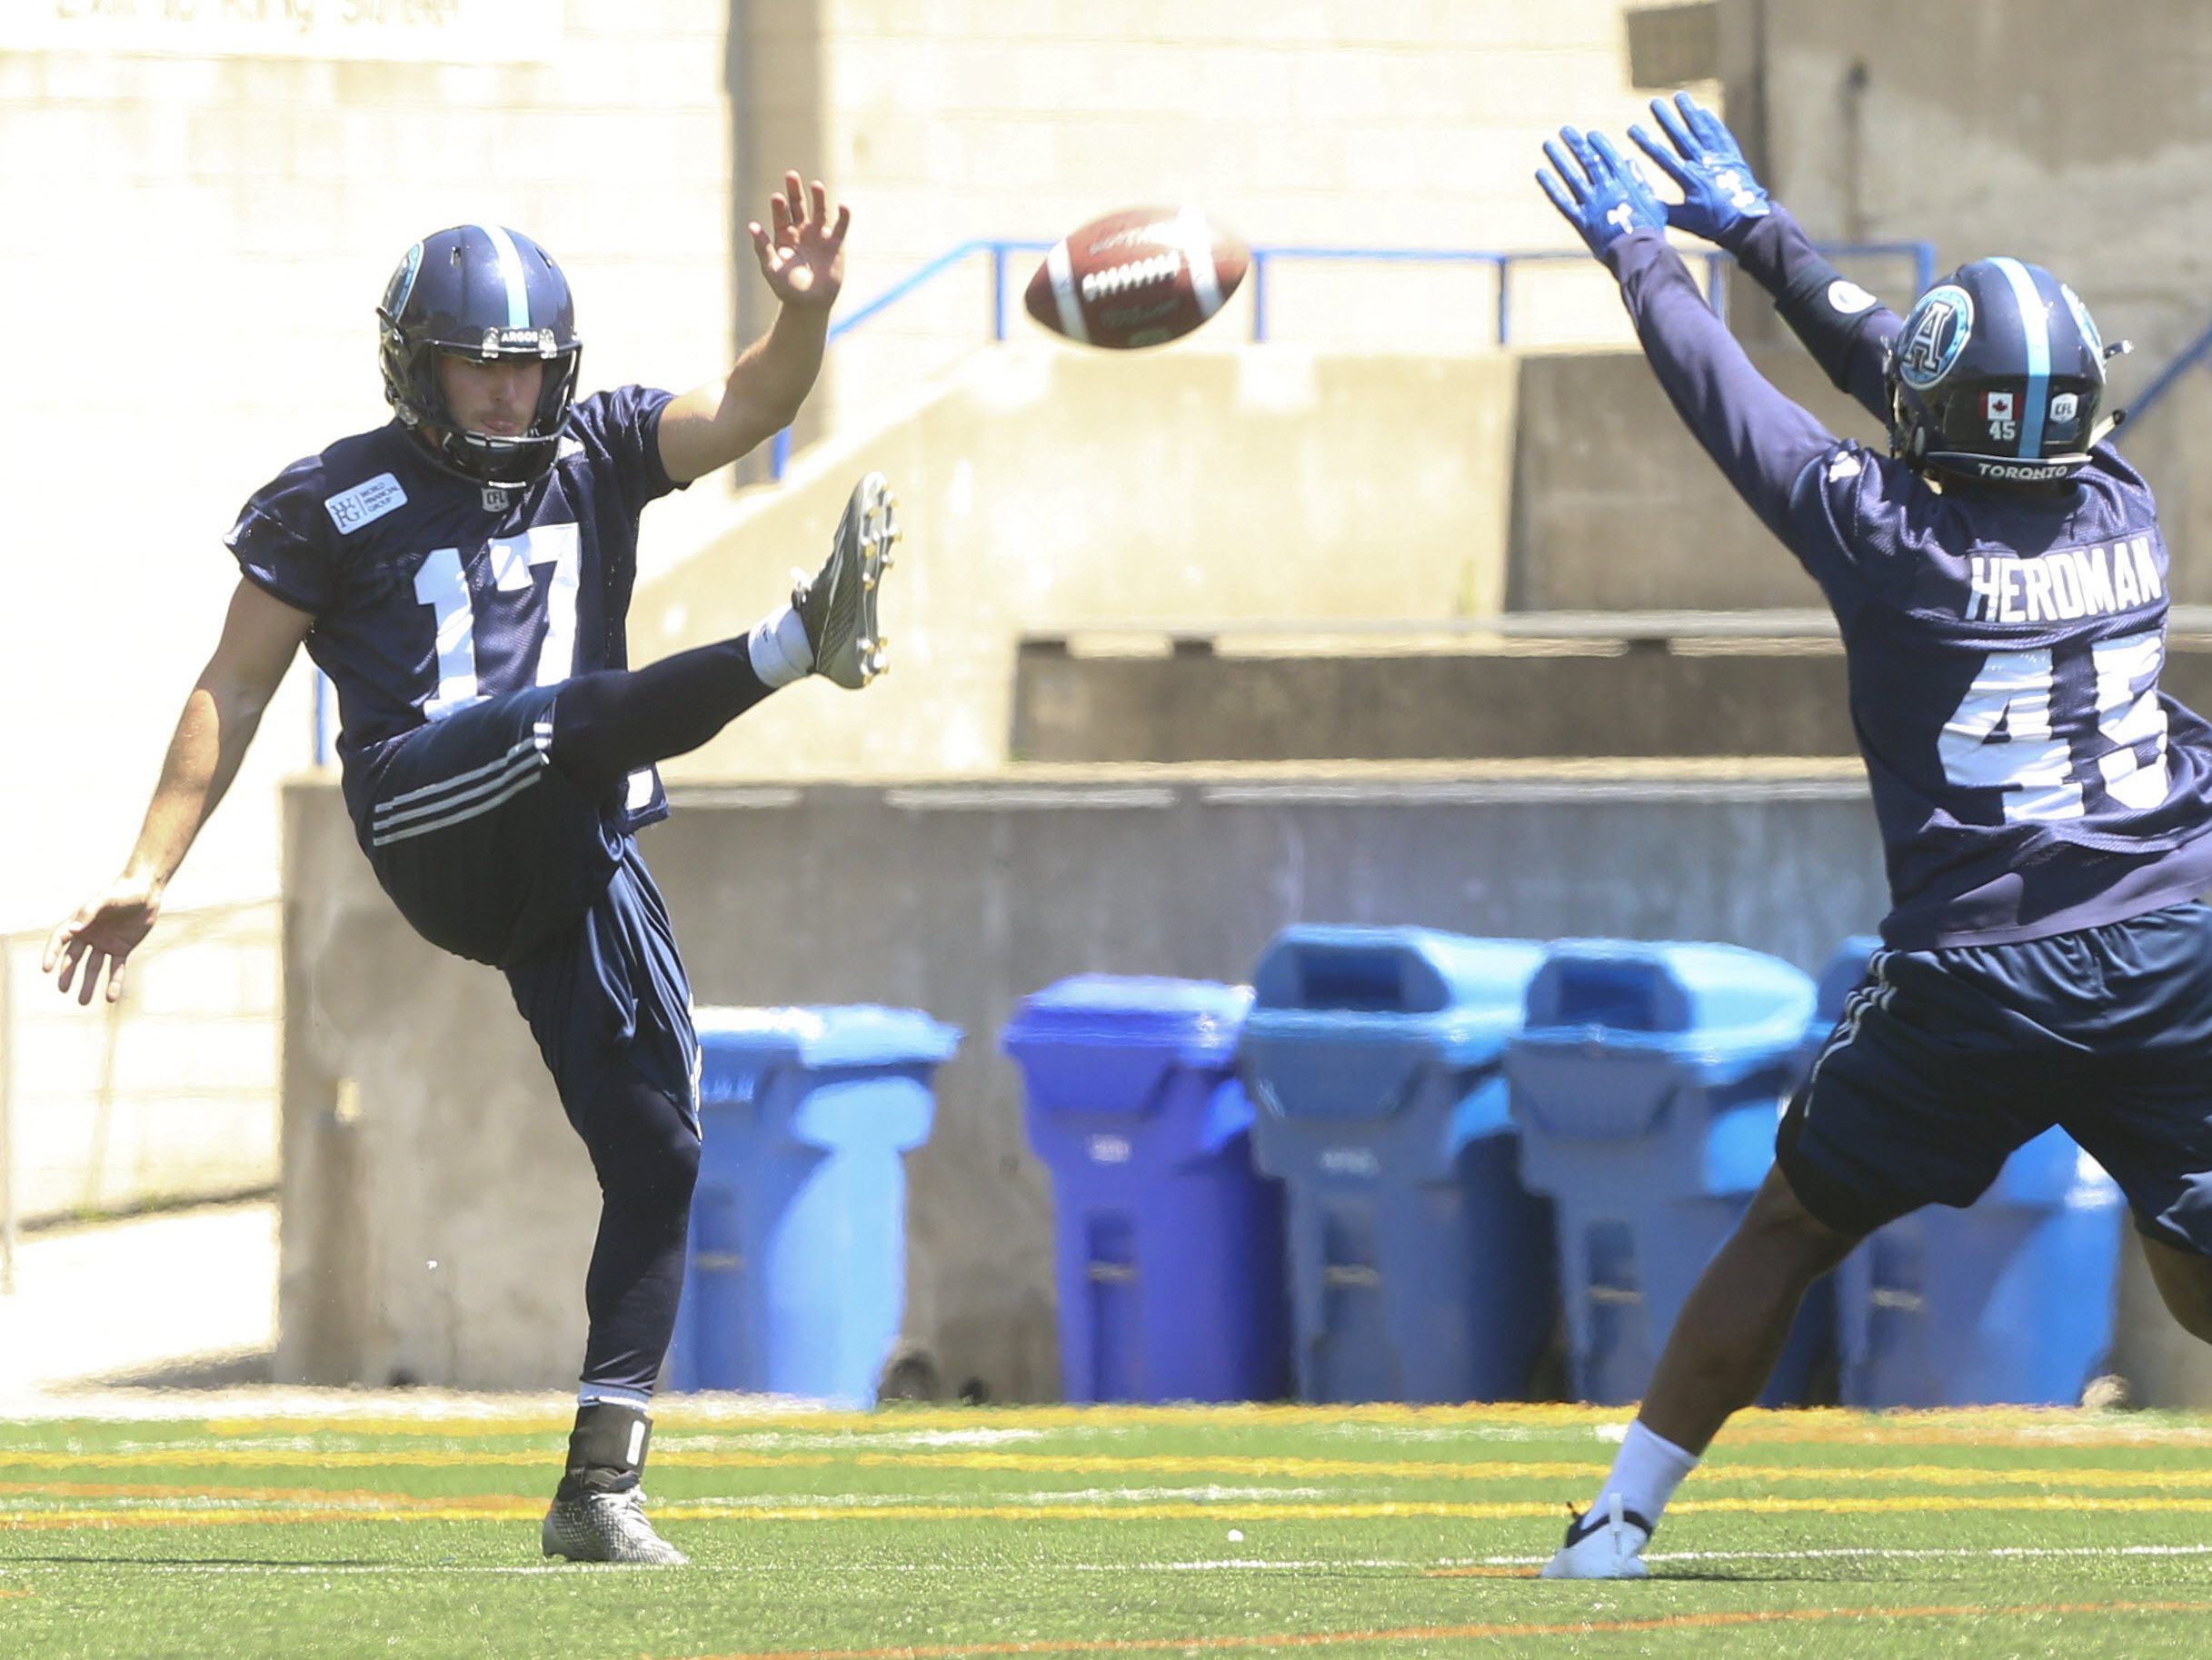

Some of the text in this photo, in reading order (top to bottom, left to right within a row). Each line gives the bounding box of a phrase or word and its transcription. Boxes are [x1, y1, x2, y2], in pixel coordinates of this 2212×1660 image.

[501, 331, 538, 343] ARGOS
[2056, 403, 2072, 415] CFL
[1988, 422, 2016, 441] 45
[1978, 462, 2068, 480] TORONTO
[1965, 537, 2162, 622] HERDMAN
[414, 522, 581, 721] 17
[1937, 629, 2169, 824] 45
